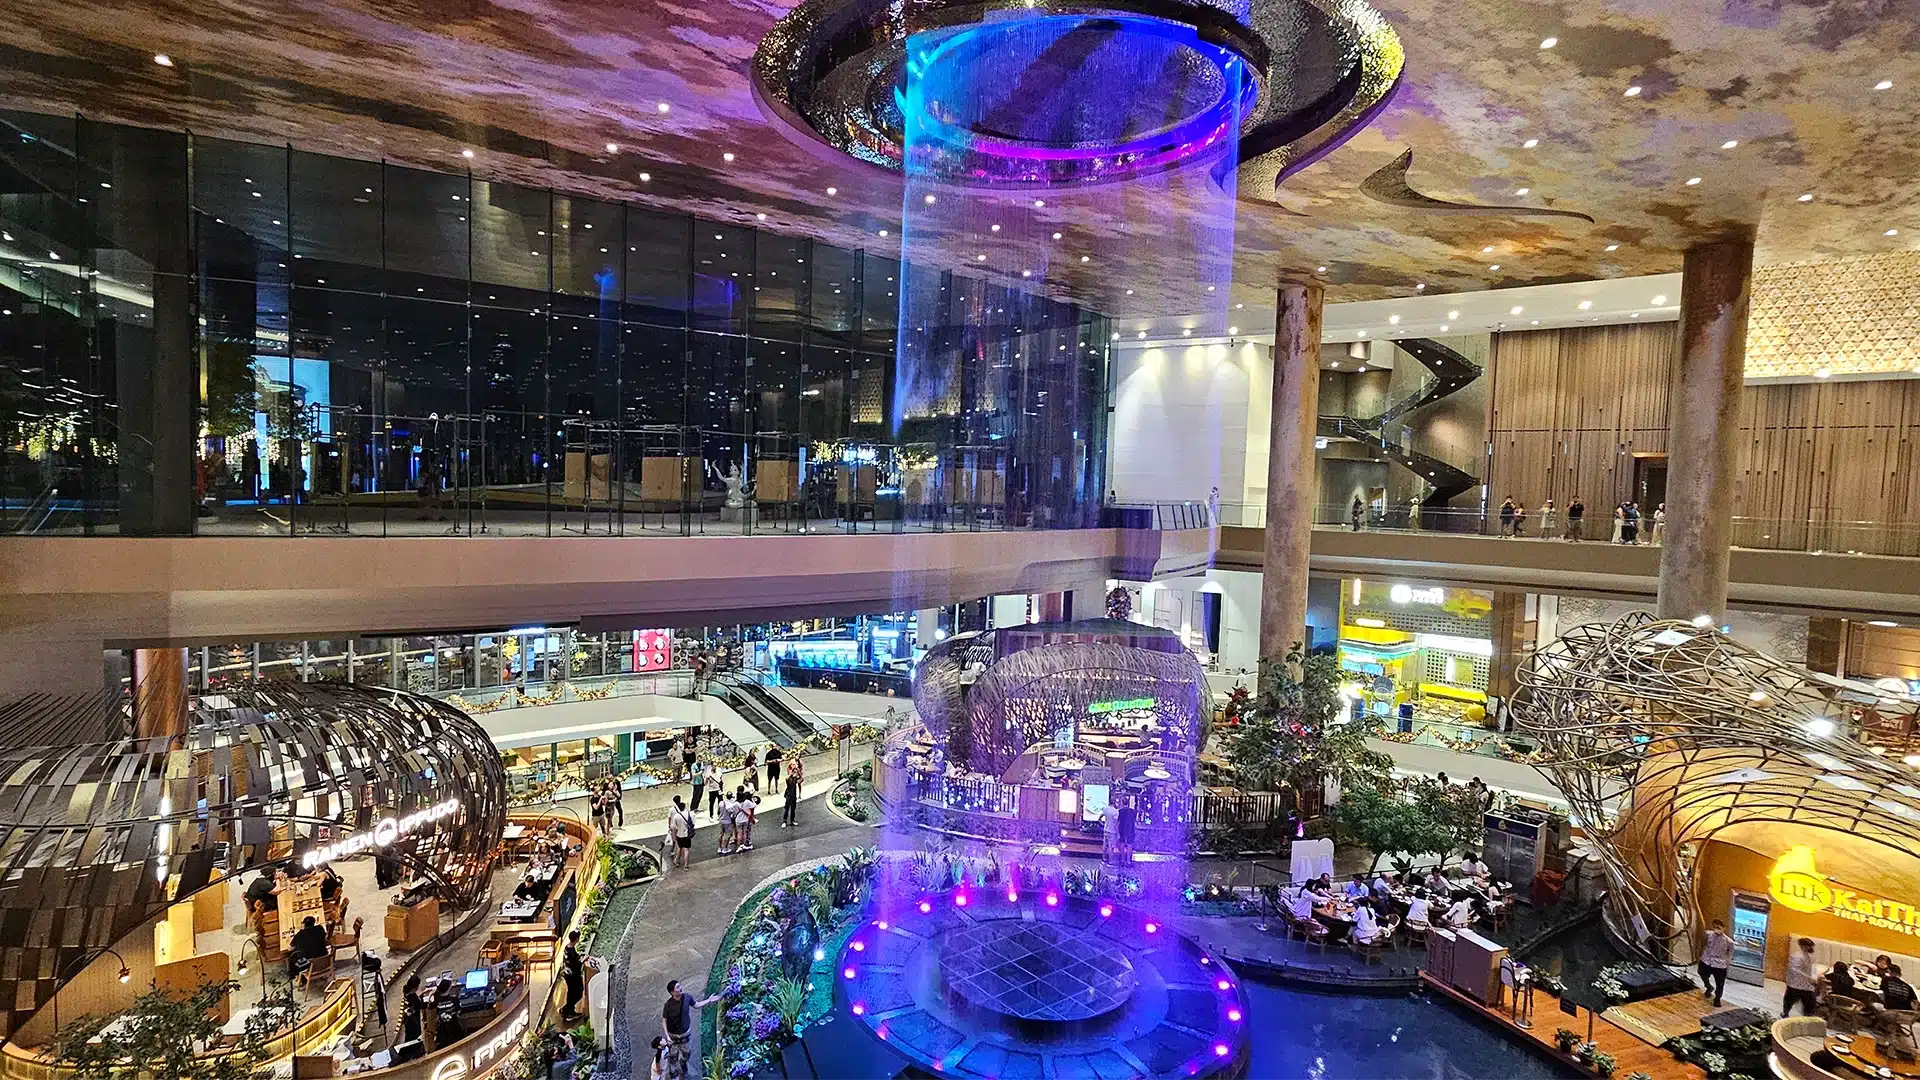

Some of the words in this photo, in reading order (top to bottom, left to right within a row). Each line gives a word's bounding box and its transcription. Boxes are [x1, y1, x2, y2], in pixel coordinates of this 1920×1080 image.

[302, 830, 374, 870] RAMEN
[398, 798, 460, 834] IPPUDO
[1779, 877, 1824, 904] Luk
